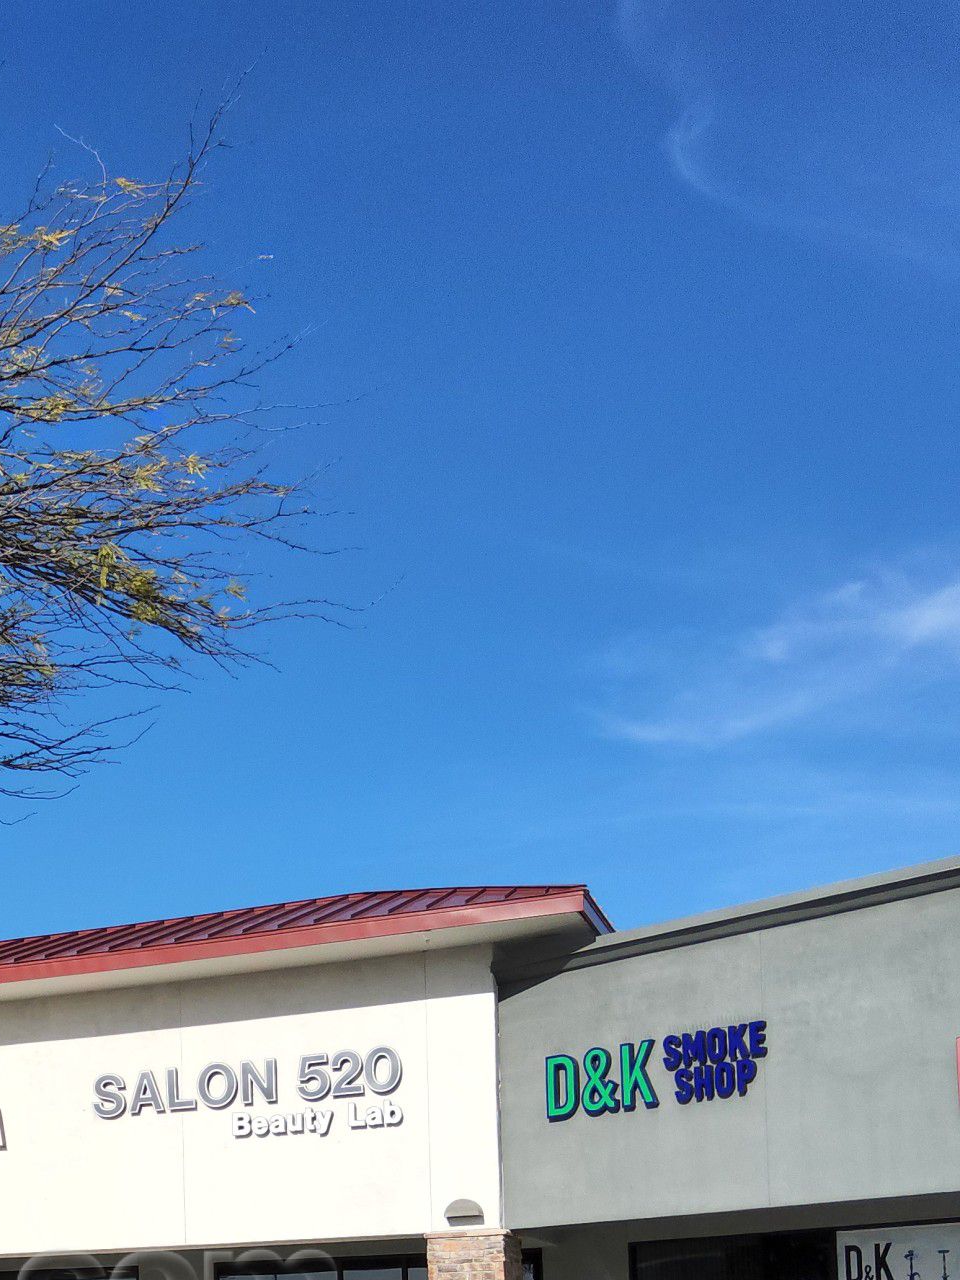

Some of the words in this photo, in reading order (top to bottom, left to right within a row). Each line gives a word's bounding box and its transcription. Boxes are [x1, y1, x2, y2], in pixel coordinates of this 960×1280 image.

[662, 1020, 768, 1071] SMOKE
[92, 1058, 279, 1120] SALON
[296, 1045, 404, 1102] 520
[545, 1039, 660, 1123] D&K
[674, 1058, 758, 1105] SHOP
[231, 1106, 334, 1140] Beauty
[347, 1098, 404, 1131] Lab
